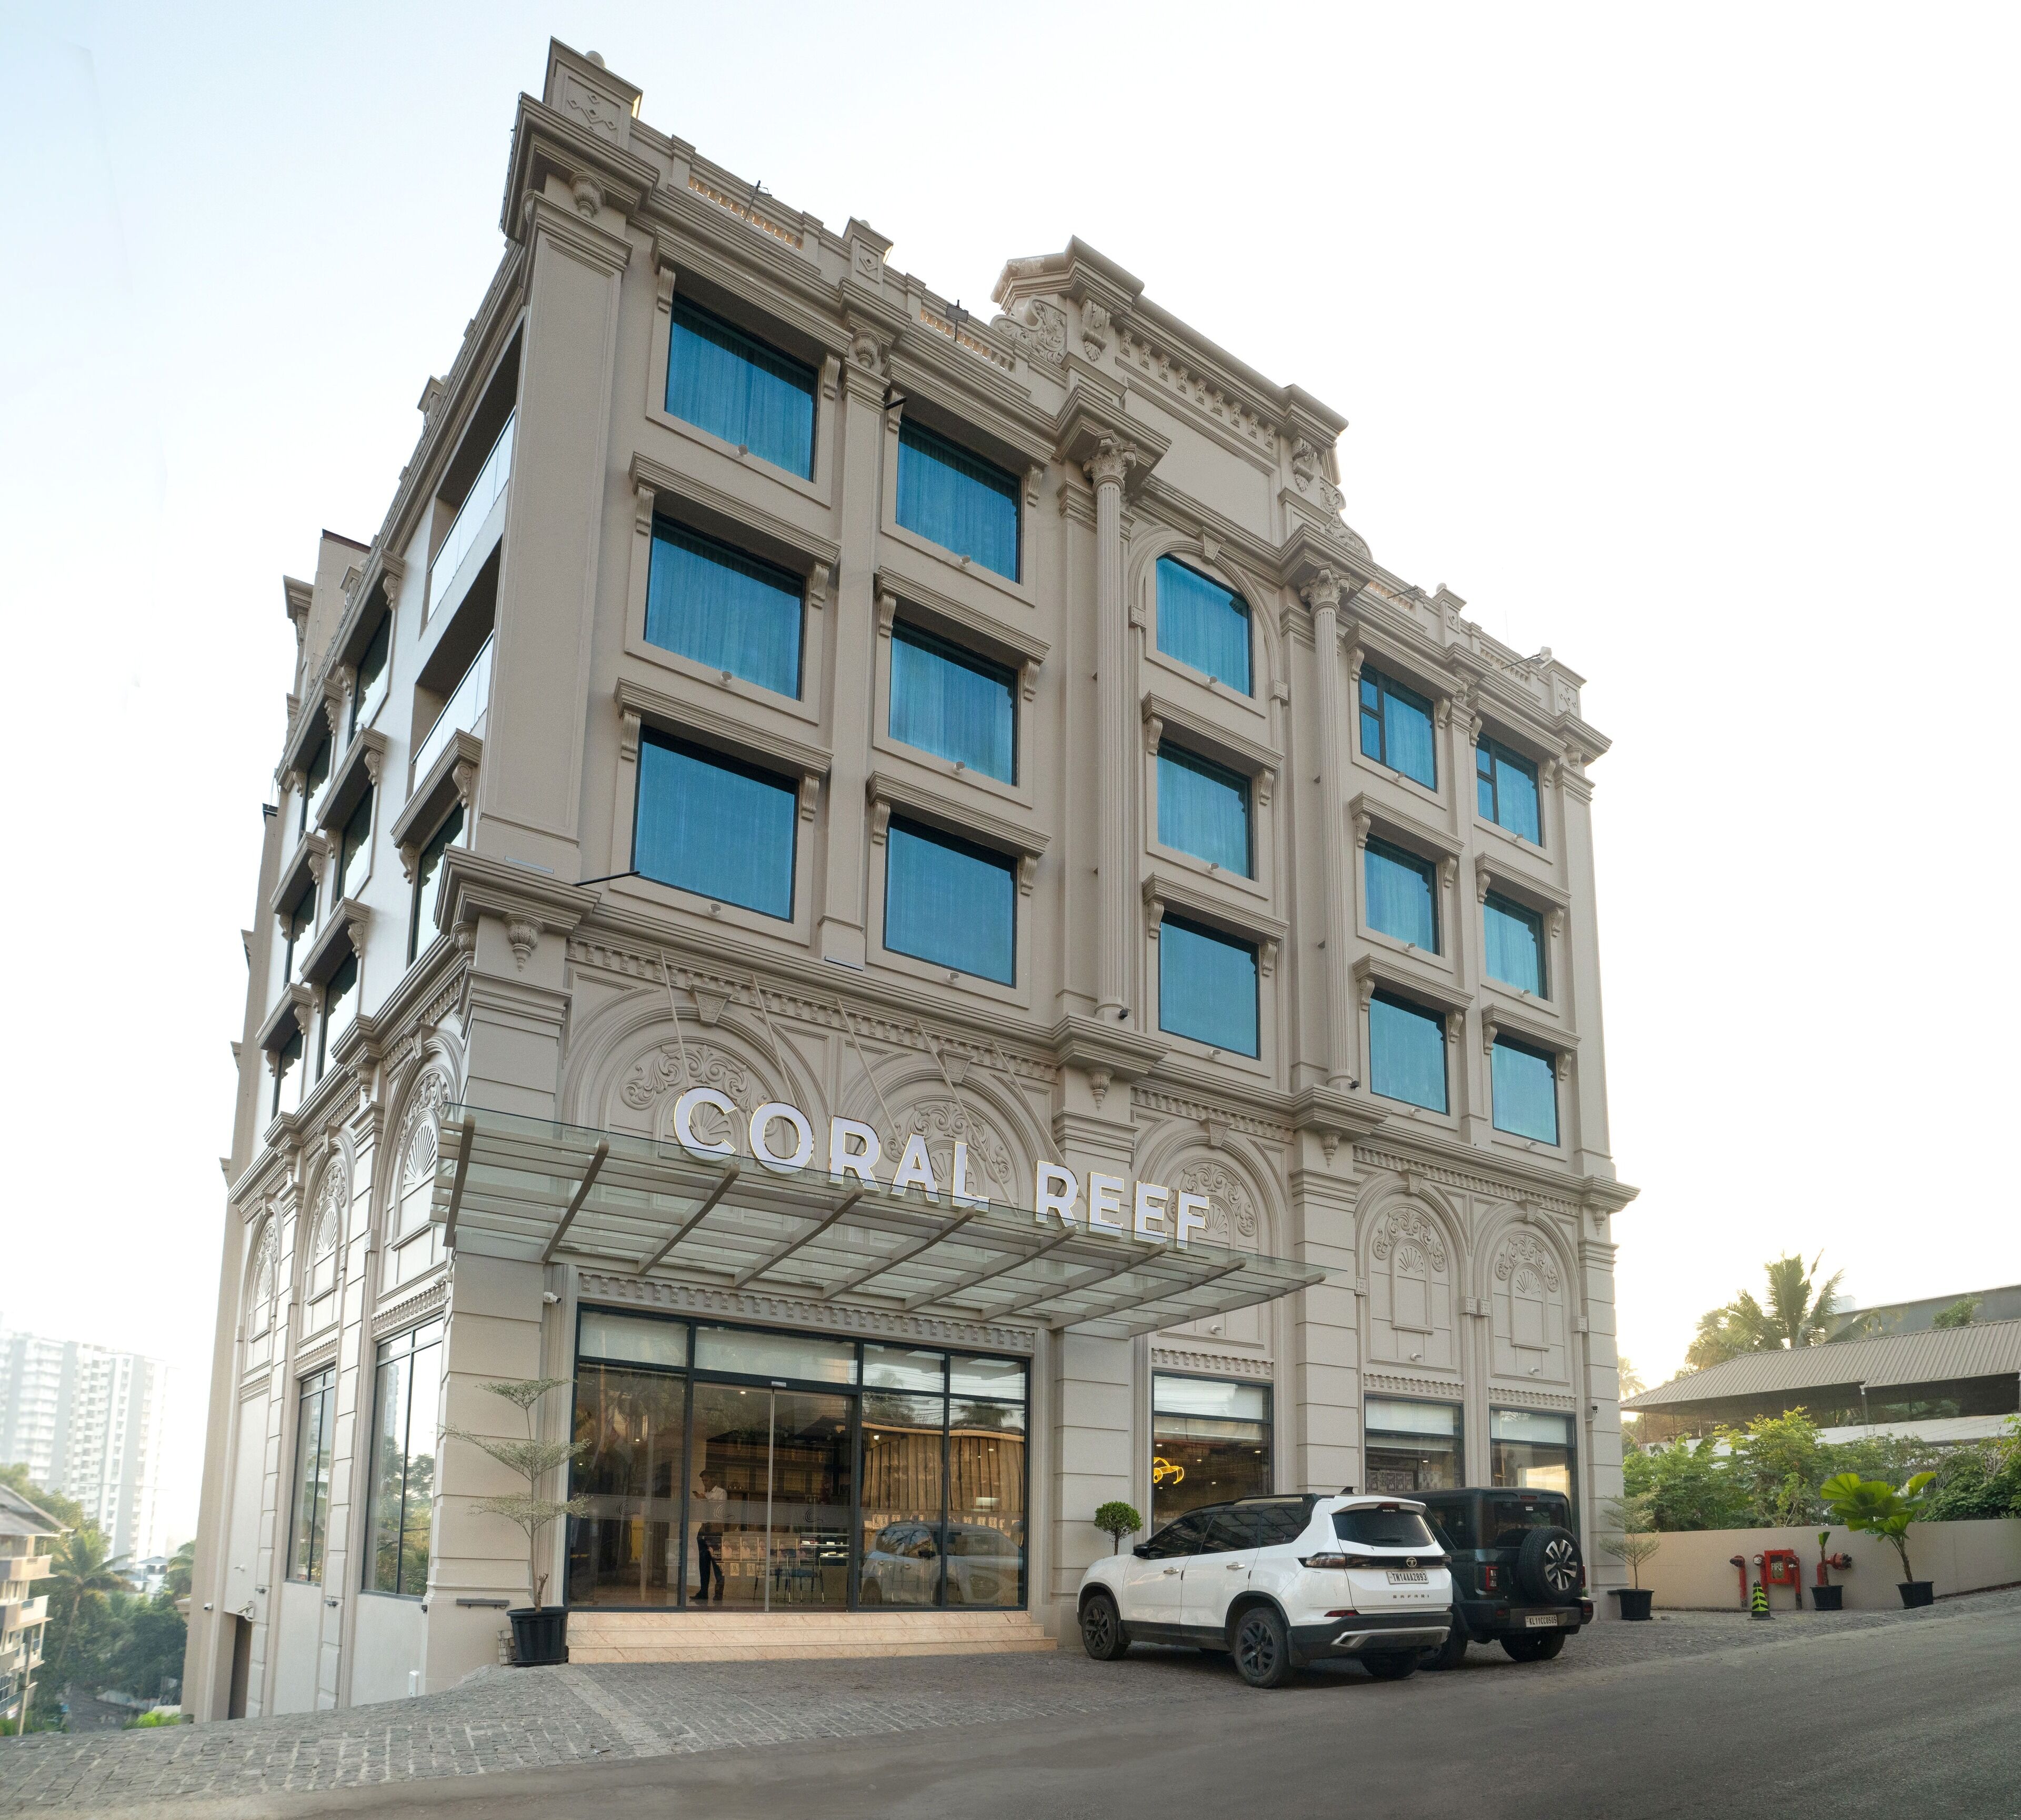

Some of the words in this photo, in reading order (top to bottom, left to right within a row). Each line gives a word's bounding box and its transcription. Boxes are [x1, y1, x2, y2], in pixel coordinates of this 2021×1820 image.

[674, 1086, 990, 1212] CORAL
[1035, 1160, 1209, 1250] REEF
[1771, 1563, 1784, 1571] FIRE
[1392, 1573, 1427, 1582] TN14AA2893
[1529, 1616, 1557, 1625] KL11CC0505
